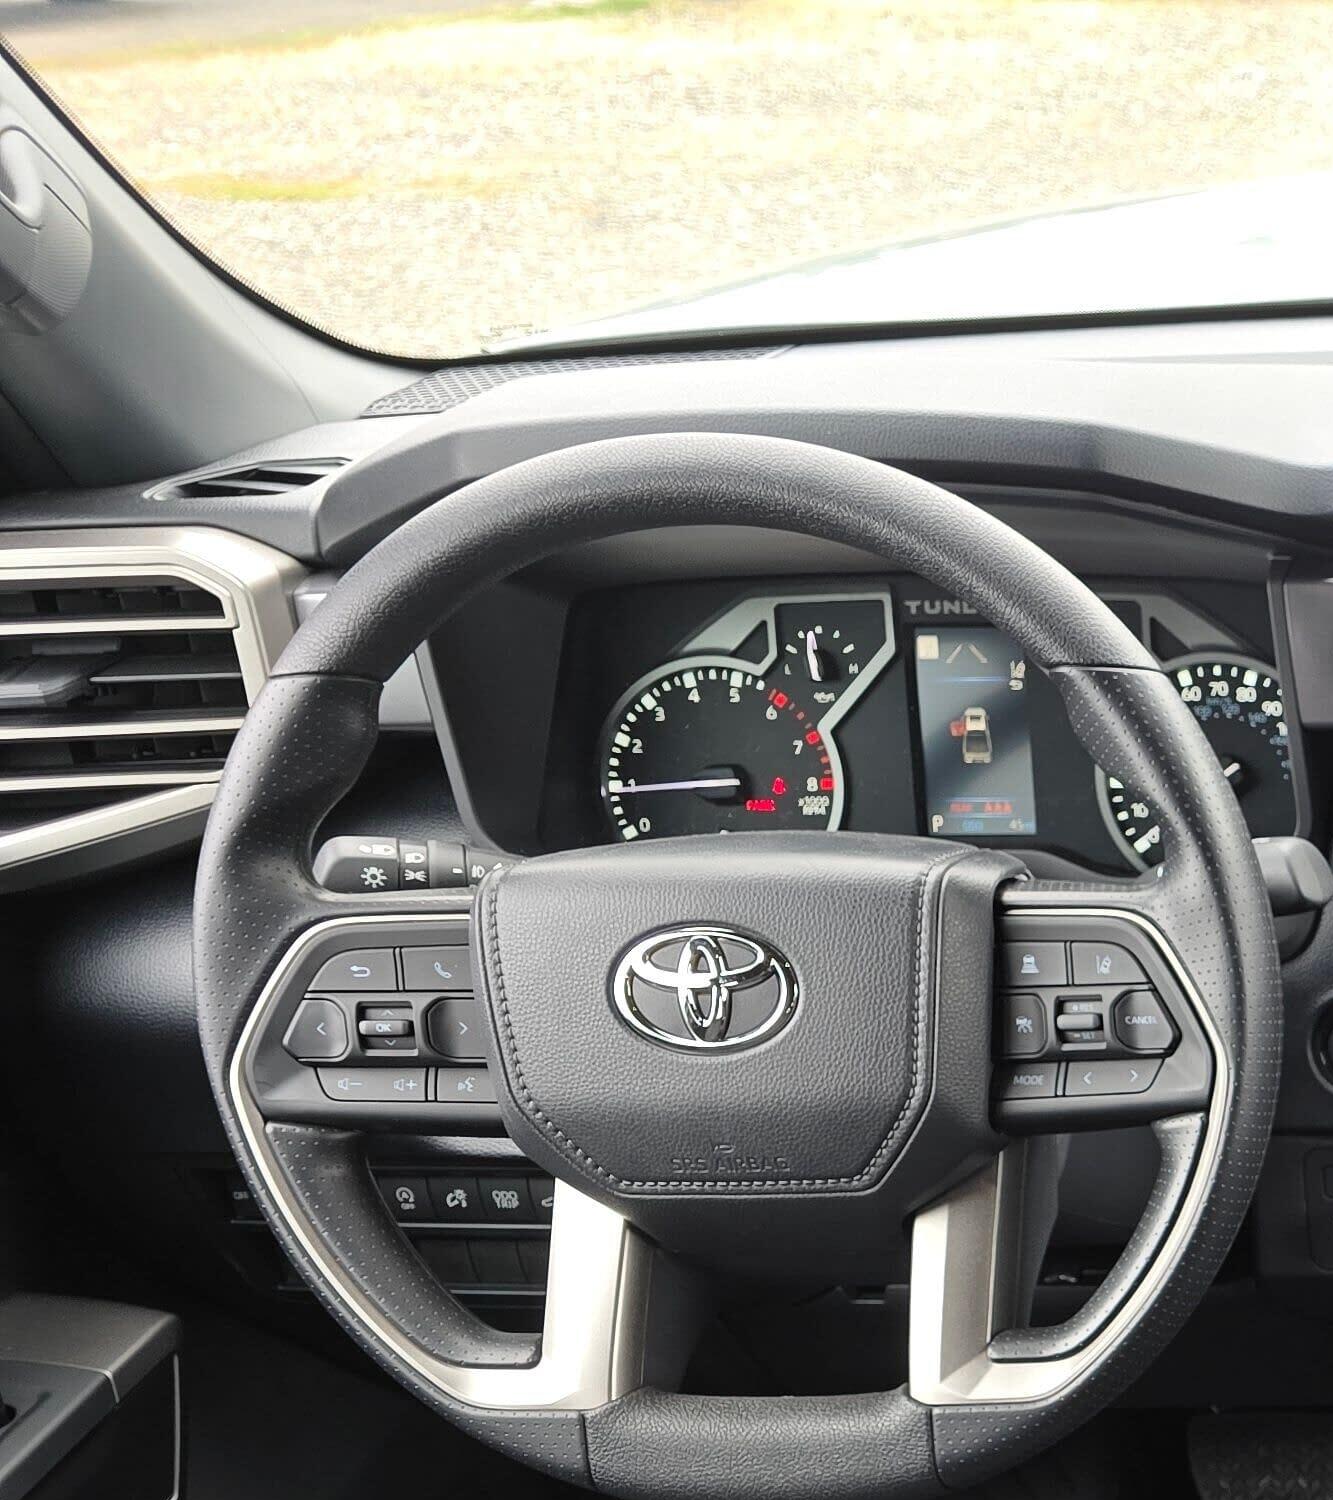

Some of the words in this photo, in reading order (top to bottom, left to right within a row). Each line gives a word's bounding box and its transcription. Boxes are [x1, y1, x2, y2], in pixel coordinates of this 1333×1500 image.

[688, 687, 701, 704] 4
[729, 687, 741, 704] 5
[1181, 685, 1202, 702] 60
[1208, 680, 1229, 697] 70
[1235, 686, 1257, 703] 80
[654, 706, 666, 722] 3
[765, 704, 778, 721] 6
[1261, 700, 1283, 717] 90
[631, 738, 644, 754] 2
[792, 739, 804, 756] 7
[806, 776, 818, 792] 8
[1131, 802, 1149, 818] 10
[638, 817, 650, 833] 0
[931, 814, 944, 833] P
[375, 1023, 393, 1033] OK
[1124, 1015, 1159, 1025] CANCEL
[1013, 1073, 1045, 1086] MODE
